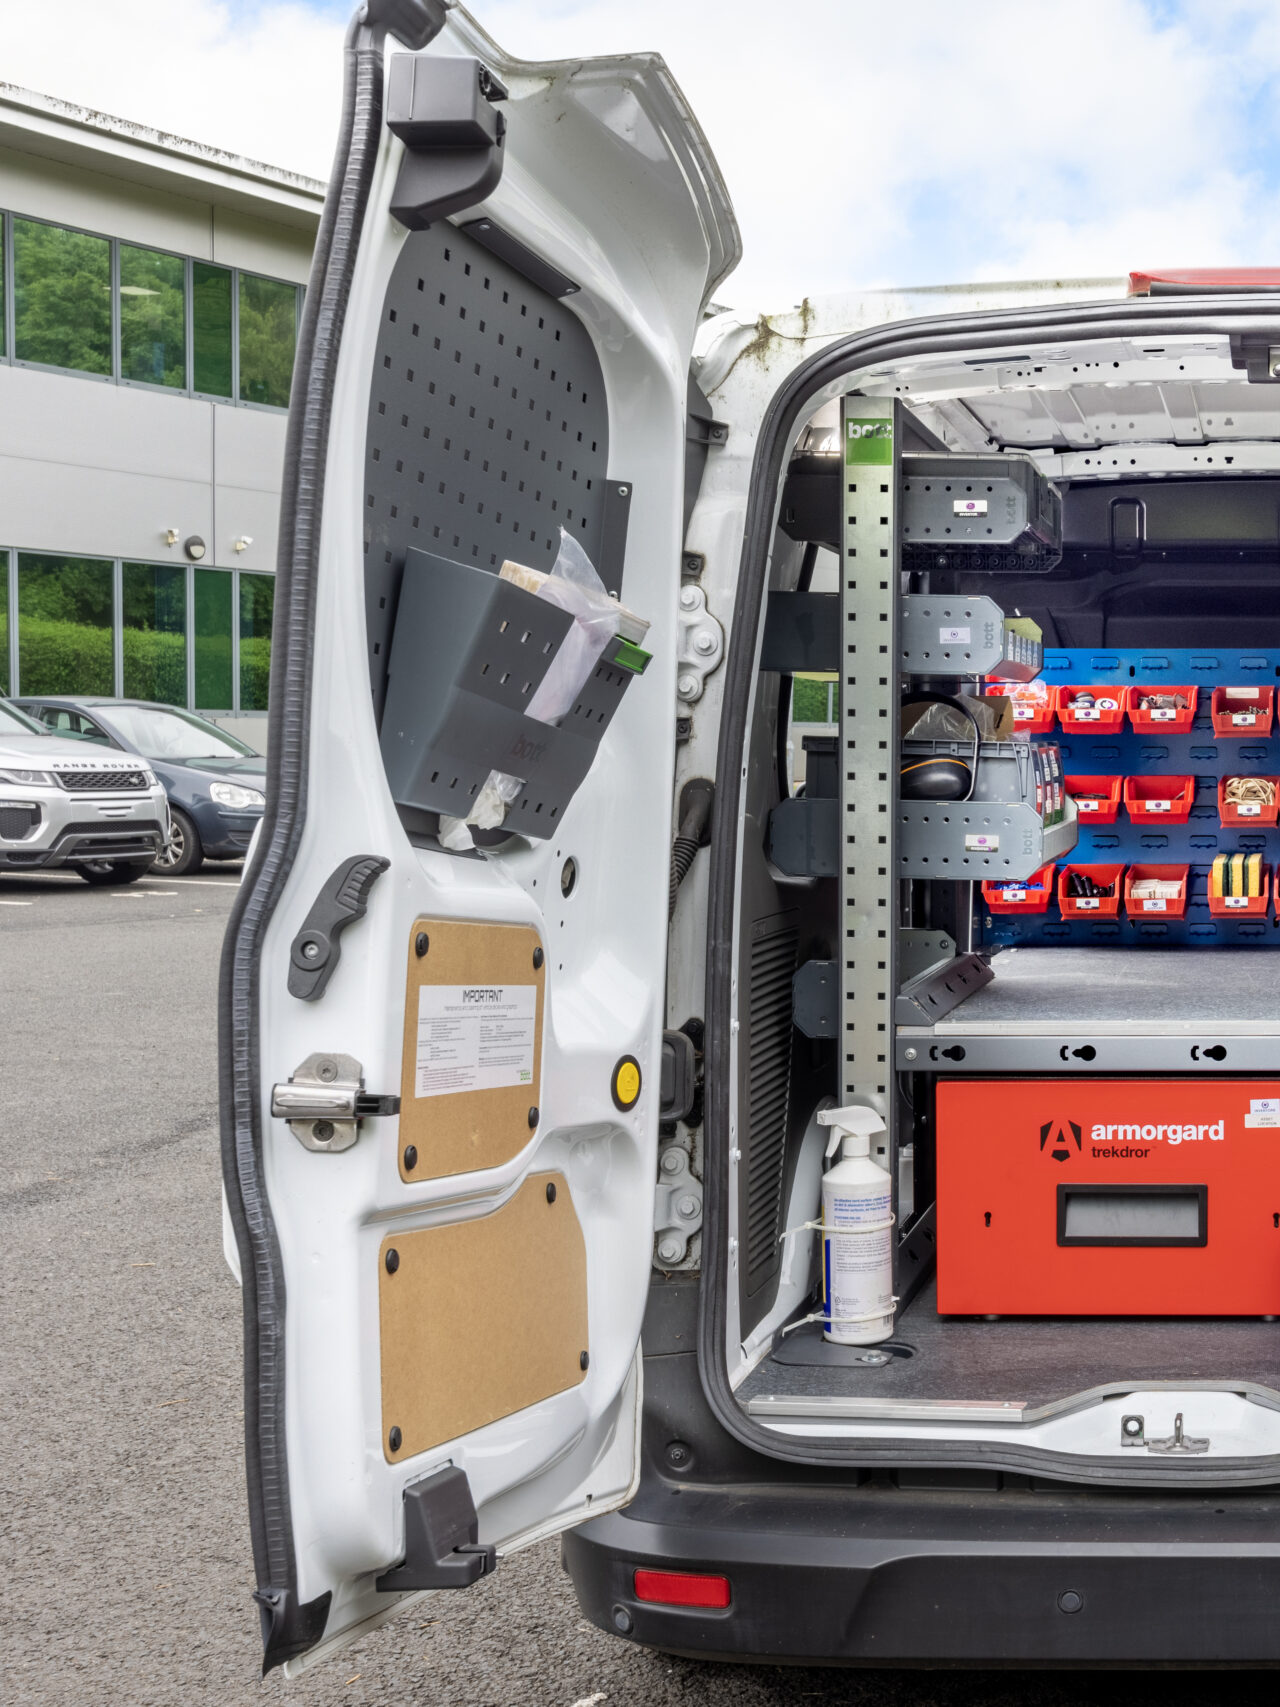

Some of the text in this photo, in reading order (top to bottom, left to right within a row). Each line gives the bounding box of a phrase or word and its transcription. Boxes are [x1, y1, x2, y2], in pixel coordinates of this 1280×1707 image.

[984, 621, 994, 649] bott
[1022, 828, 1033, 855] bott
[462, 989, 503, 1003] IMPORTANT
[1091, 1119, 1225, 1145] armorgard
[1091, 1145, 1151, 1159] trekdror
